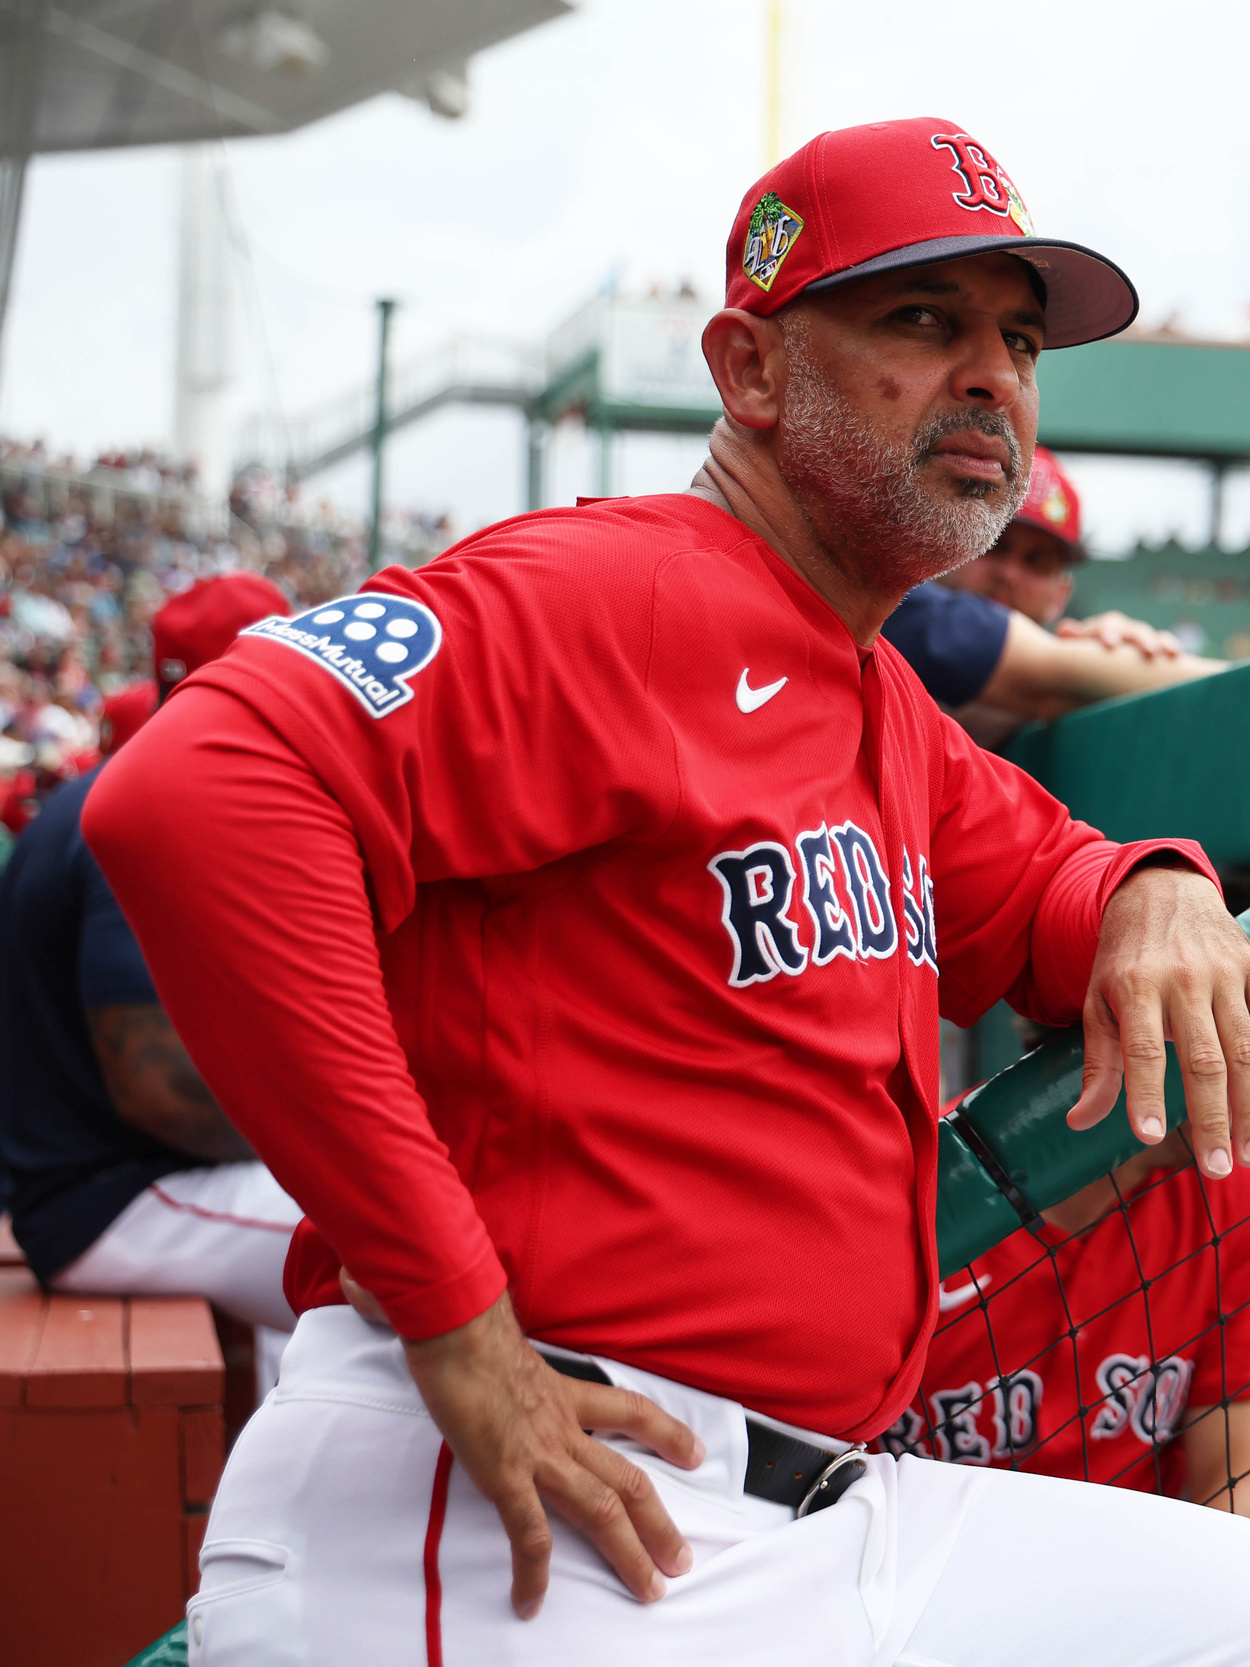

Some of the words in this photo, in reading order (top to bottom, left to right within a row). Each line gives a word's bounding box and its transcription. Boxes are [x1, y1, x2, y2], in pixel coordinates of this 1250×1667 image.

[931, 134, 1016, 217] B
[255, 620, 400, 706] MassMutual
[707, 820, 898, 988] RED
